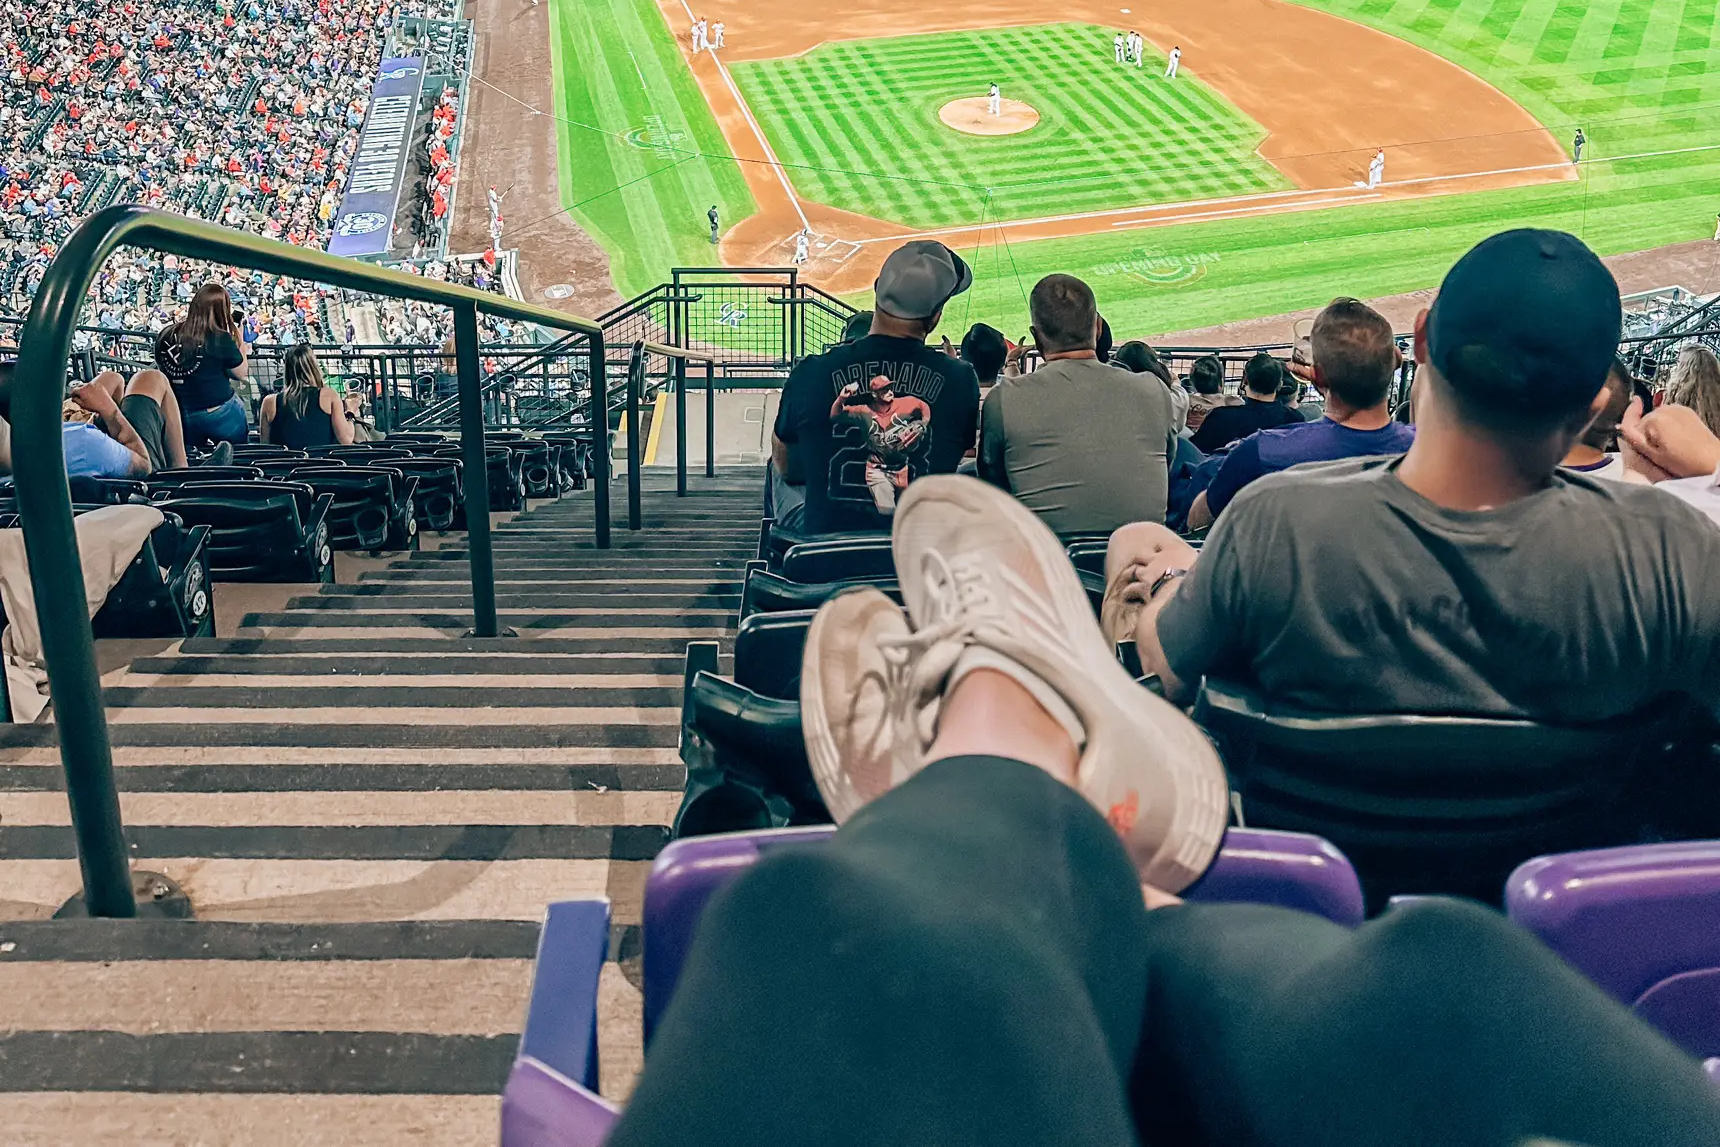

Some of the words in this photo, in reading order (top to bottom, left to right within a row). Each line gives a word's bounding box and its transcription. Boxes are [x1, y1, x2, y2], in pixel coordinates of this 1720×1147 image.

[361, 95, 413, 149] CELEBRATING
[357, 148, 400, 163] 30
[348, 161, 398, 194] YEARS
[831, 360, 946, 404] ARENADO
